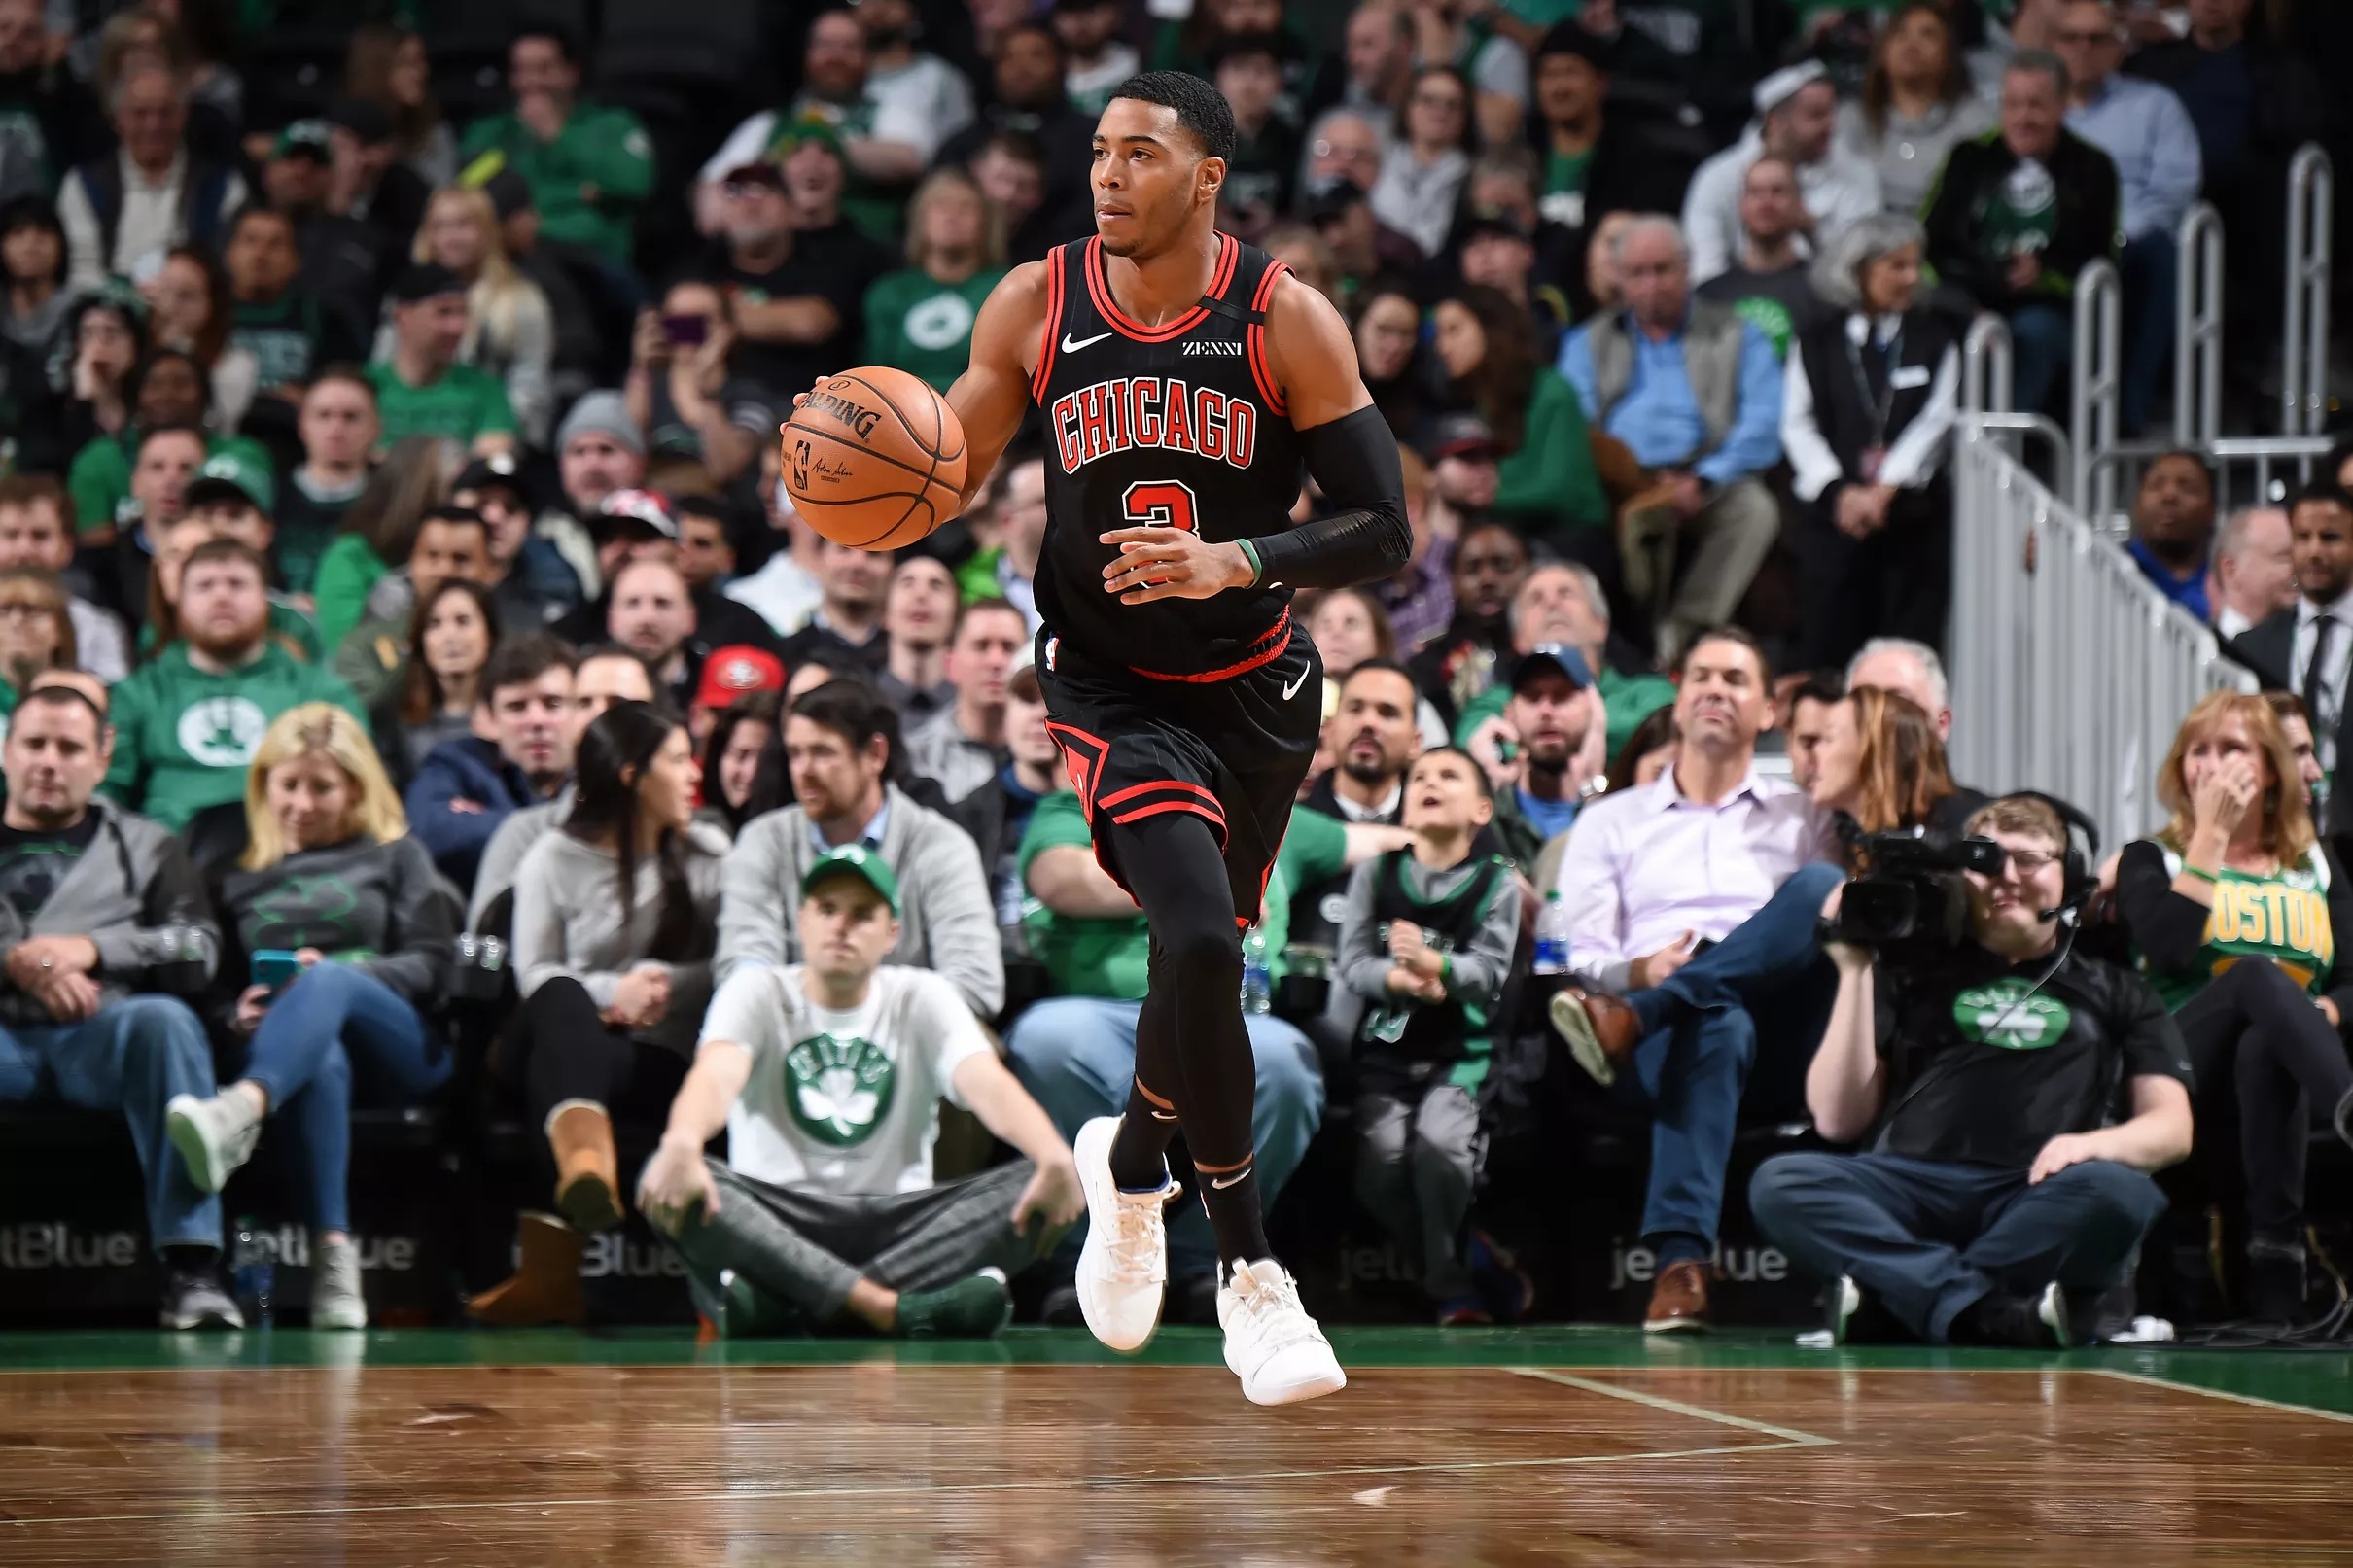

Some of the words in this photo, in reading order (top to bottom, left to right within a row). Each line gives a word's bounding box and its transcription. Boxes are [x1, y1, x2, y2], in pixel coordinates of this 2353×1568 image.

[1182, 341, 1242, 356] ZENNI
[1051, 376, 1257, 475] CHICAGO
[2200, 879, 2334, 966] OSTON
